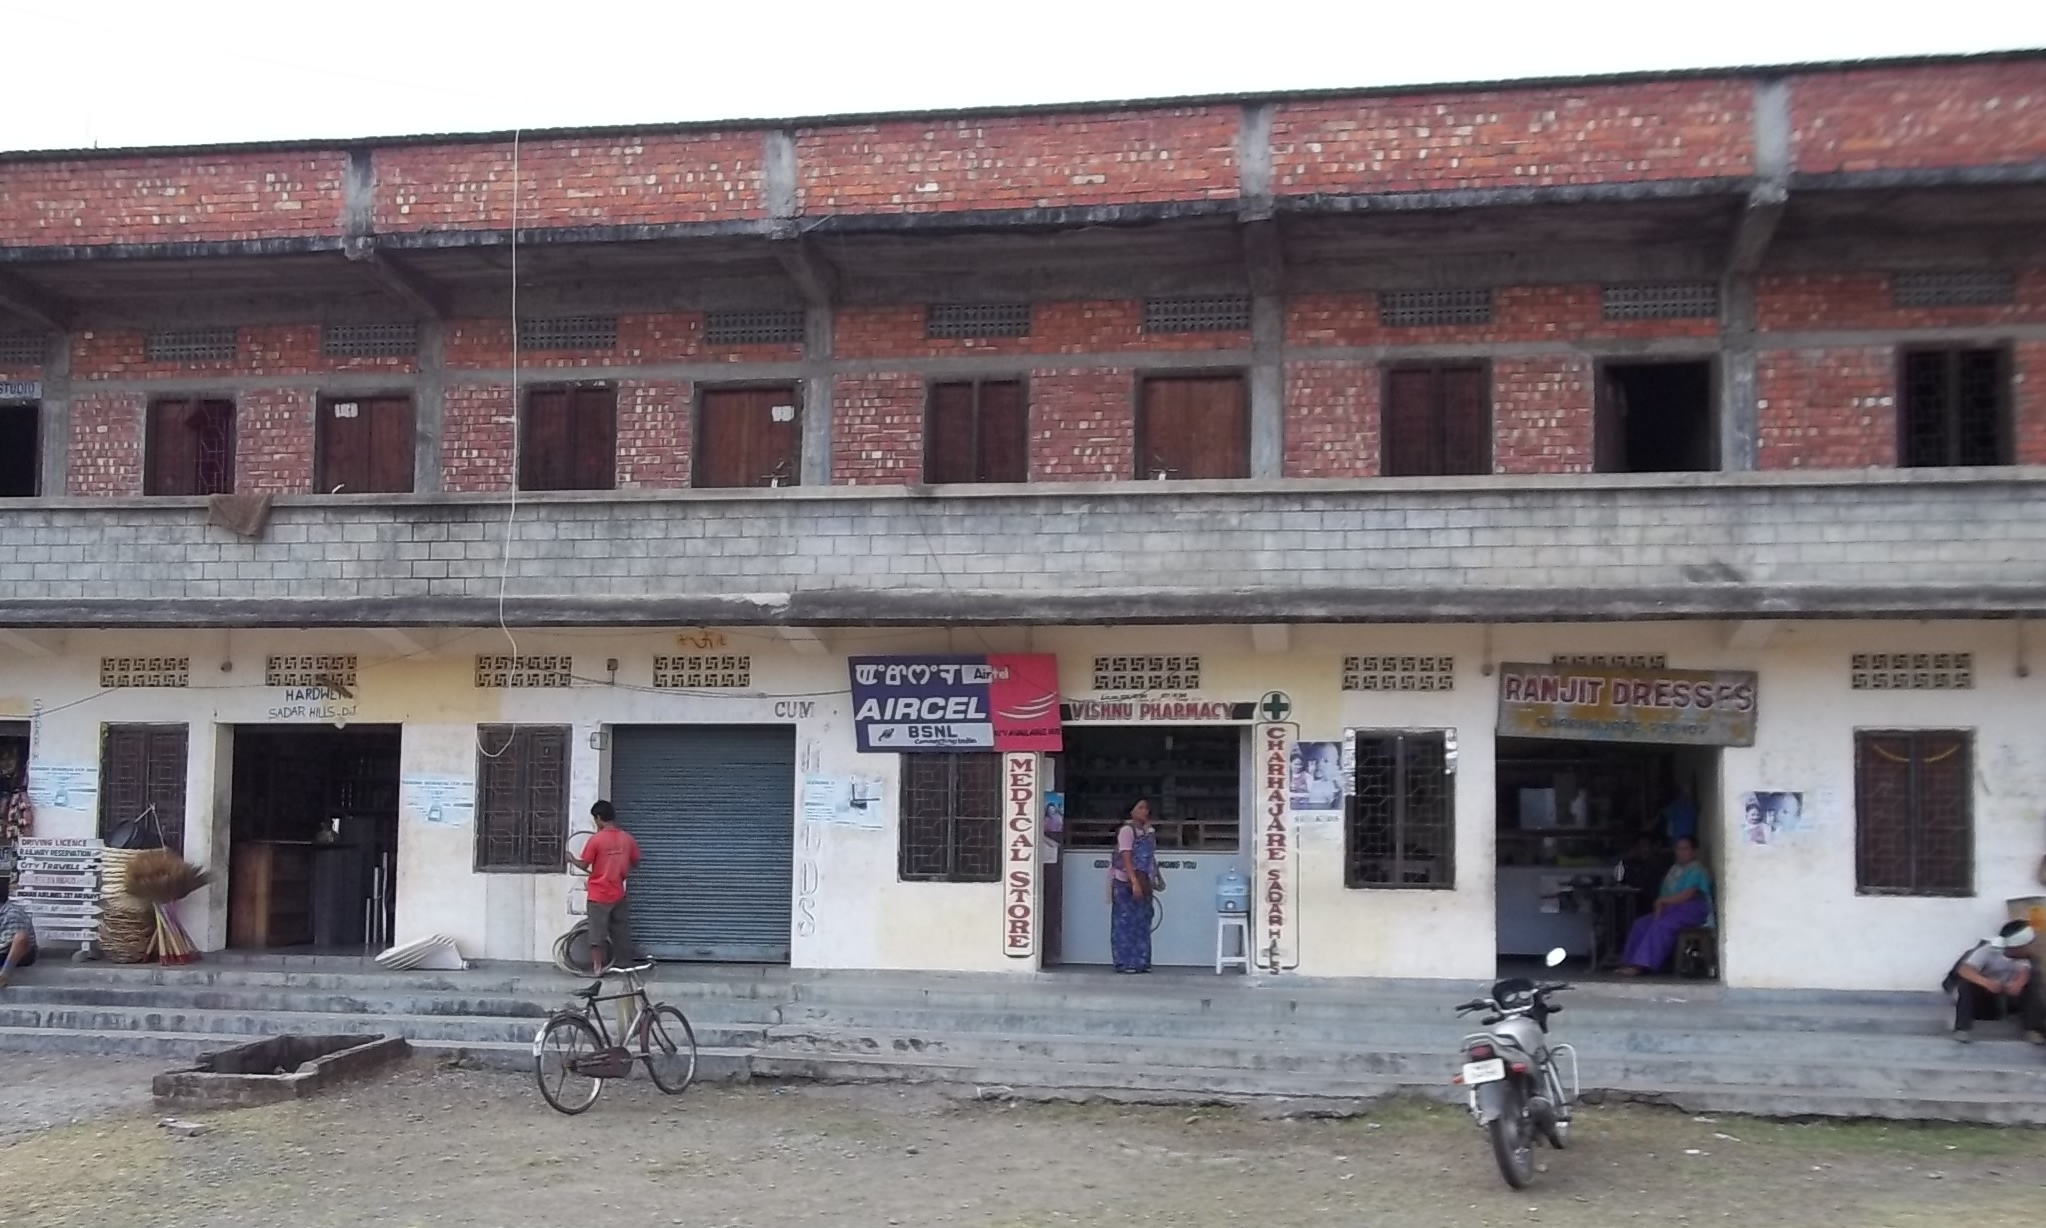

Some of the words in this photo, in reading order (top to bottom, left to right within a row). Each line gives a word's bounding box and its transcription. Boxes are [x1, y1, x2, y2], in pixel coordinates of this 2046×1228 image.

[974, 666, 1009, 680] Airtel
[1503, 674, 1606, 705] RANJIT
[1611, 678, 1754, 712] DRESSES
[268, 705, 306, 719] SADAR
[774, 701, 815, 719] CUM
[854, 696, 987, 721] AIRCEL
[1071, 702, 1133, 721] VISHNU
[1139, 701, 1235, 721] PHARMACY
[908, 725, 958, 738] BSNL
[1266, 727, 1287, 860] CHARHAJARE
[1009, 758, 1034, 862] MEDICAL
[21, 838, 53, 847] DRIVING
[55, 838, 88, 847] LICENCE
[19, 848, 49, 857] RAILWAY
[50, 849, 92, 858] RESERVATION
[1267, 869, 1284, 926] SADAR
[1007, 871, 1032, 949] STORE
